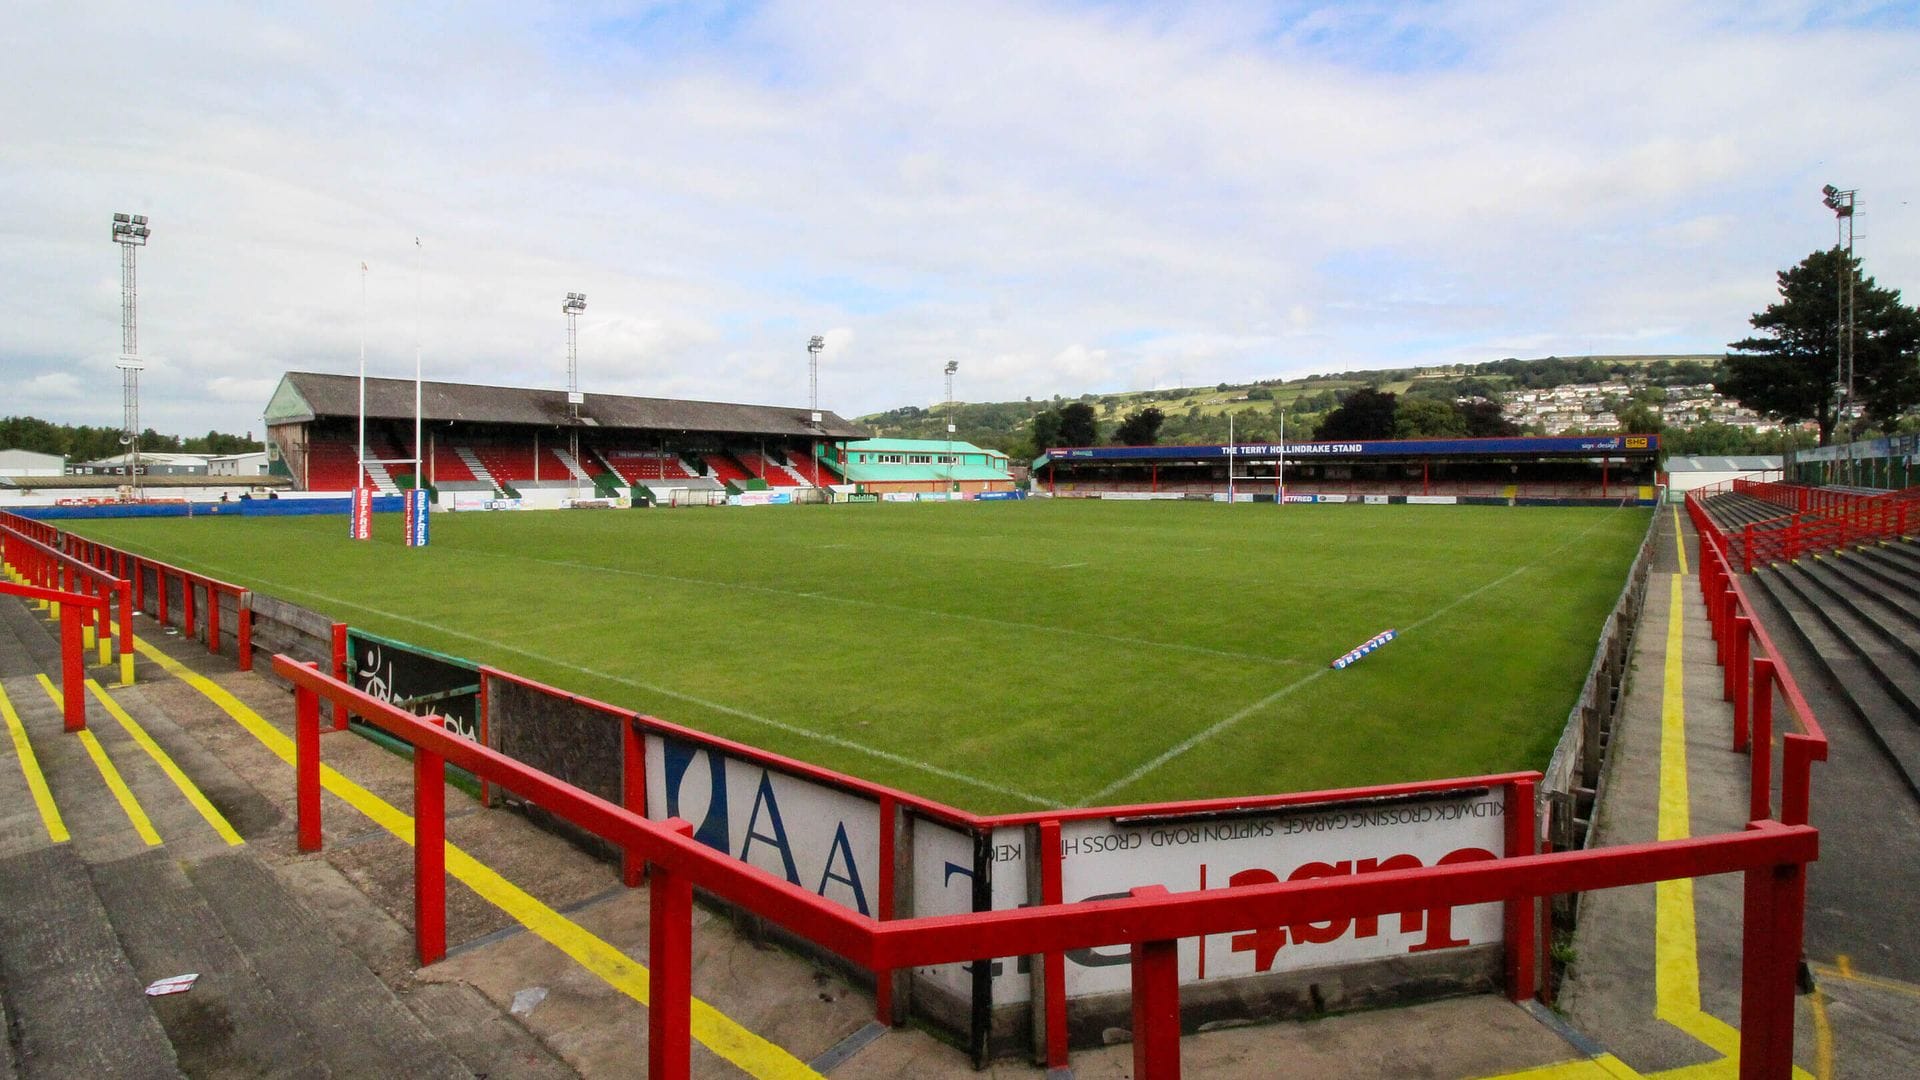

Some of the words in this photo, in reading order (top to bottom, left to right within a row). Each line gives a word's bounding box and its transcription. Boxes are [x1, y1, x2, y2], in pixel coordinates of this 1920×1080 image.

[1222, 446, 1237, 454] THE
[1241, 446, 1266, 454] TERRY
[1270, 445, 1330, 454] HOLLINDRAKE
[1333, 444, 1362, 452] STAND
[359, 489, 369, 539] BETFRED
[416, 491, 426, 546] BETFRED
[1352, 807, 1432, 828] CROSSING
[1434, 801, 1505, 821] KILDWICK
[1148, 827, 1199, 847] ROAD,
[1204, 820, 1274, 843] SKIPTON
[1083, 833, 1142, 854] CROSS
